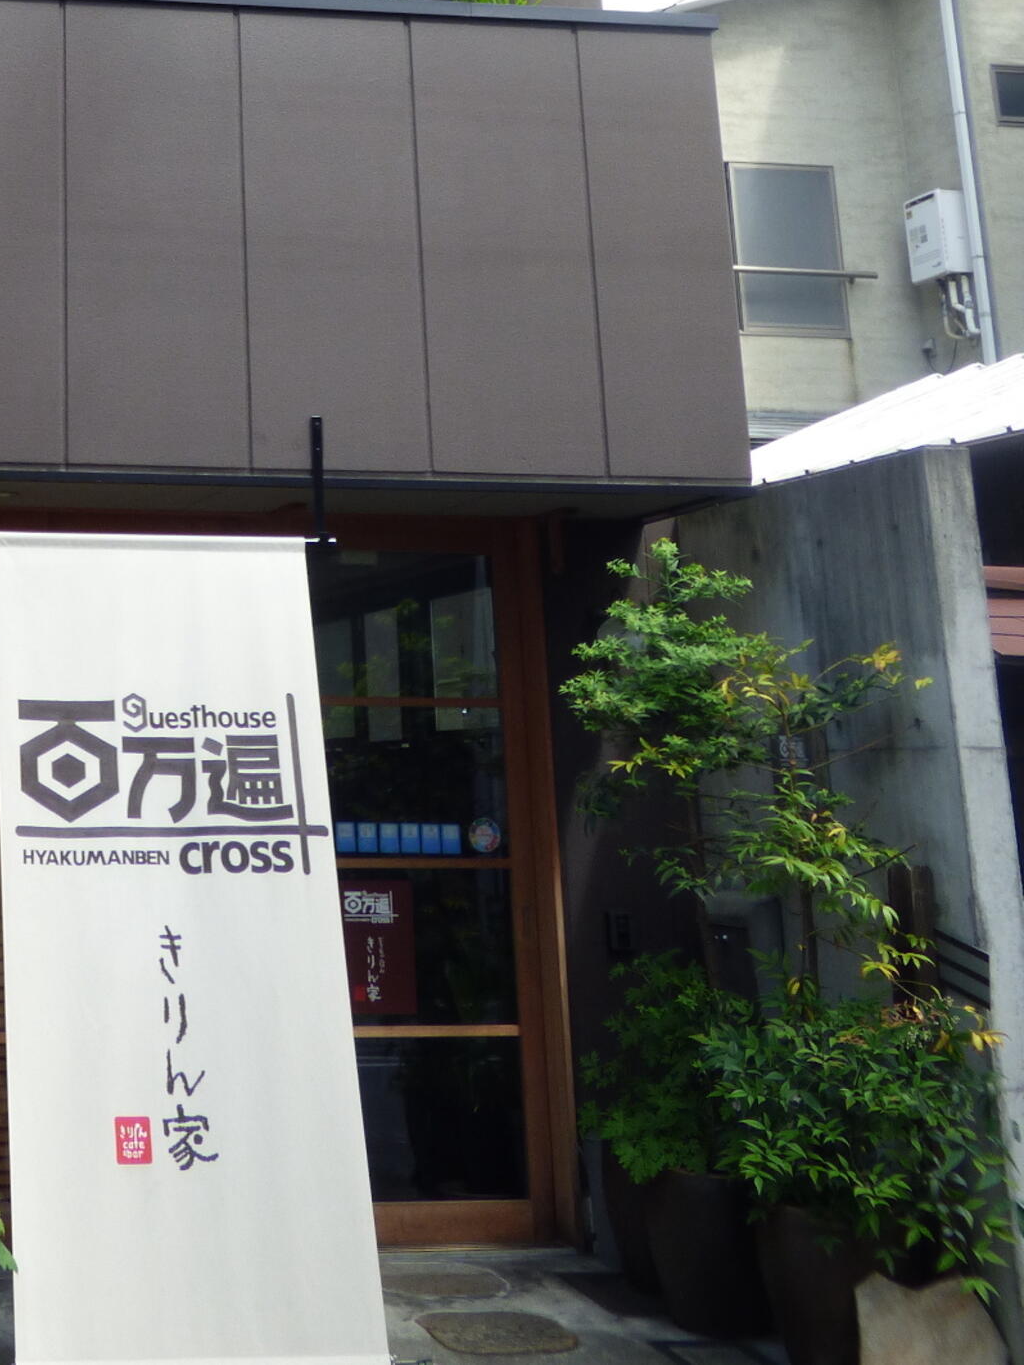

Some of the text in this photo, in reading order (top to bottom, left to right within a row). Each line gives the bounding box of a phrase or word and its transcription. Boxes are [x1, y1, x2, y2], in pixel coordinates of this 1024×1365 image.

[121, 692, 277, 733] guesthouse
[17, 698, 295, 824] 百万遍
[22, 840, 295, 875] HYAKUMANBEN cross
[158, 924, 220, 1172] きりん家
